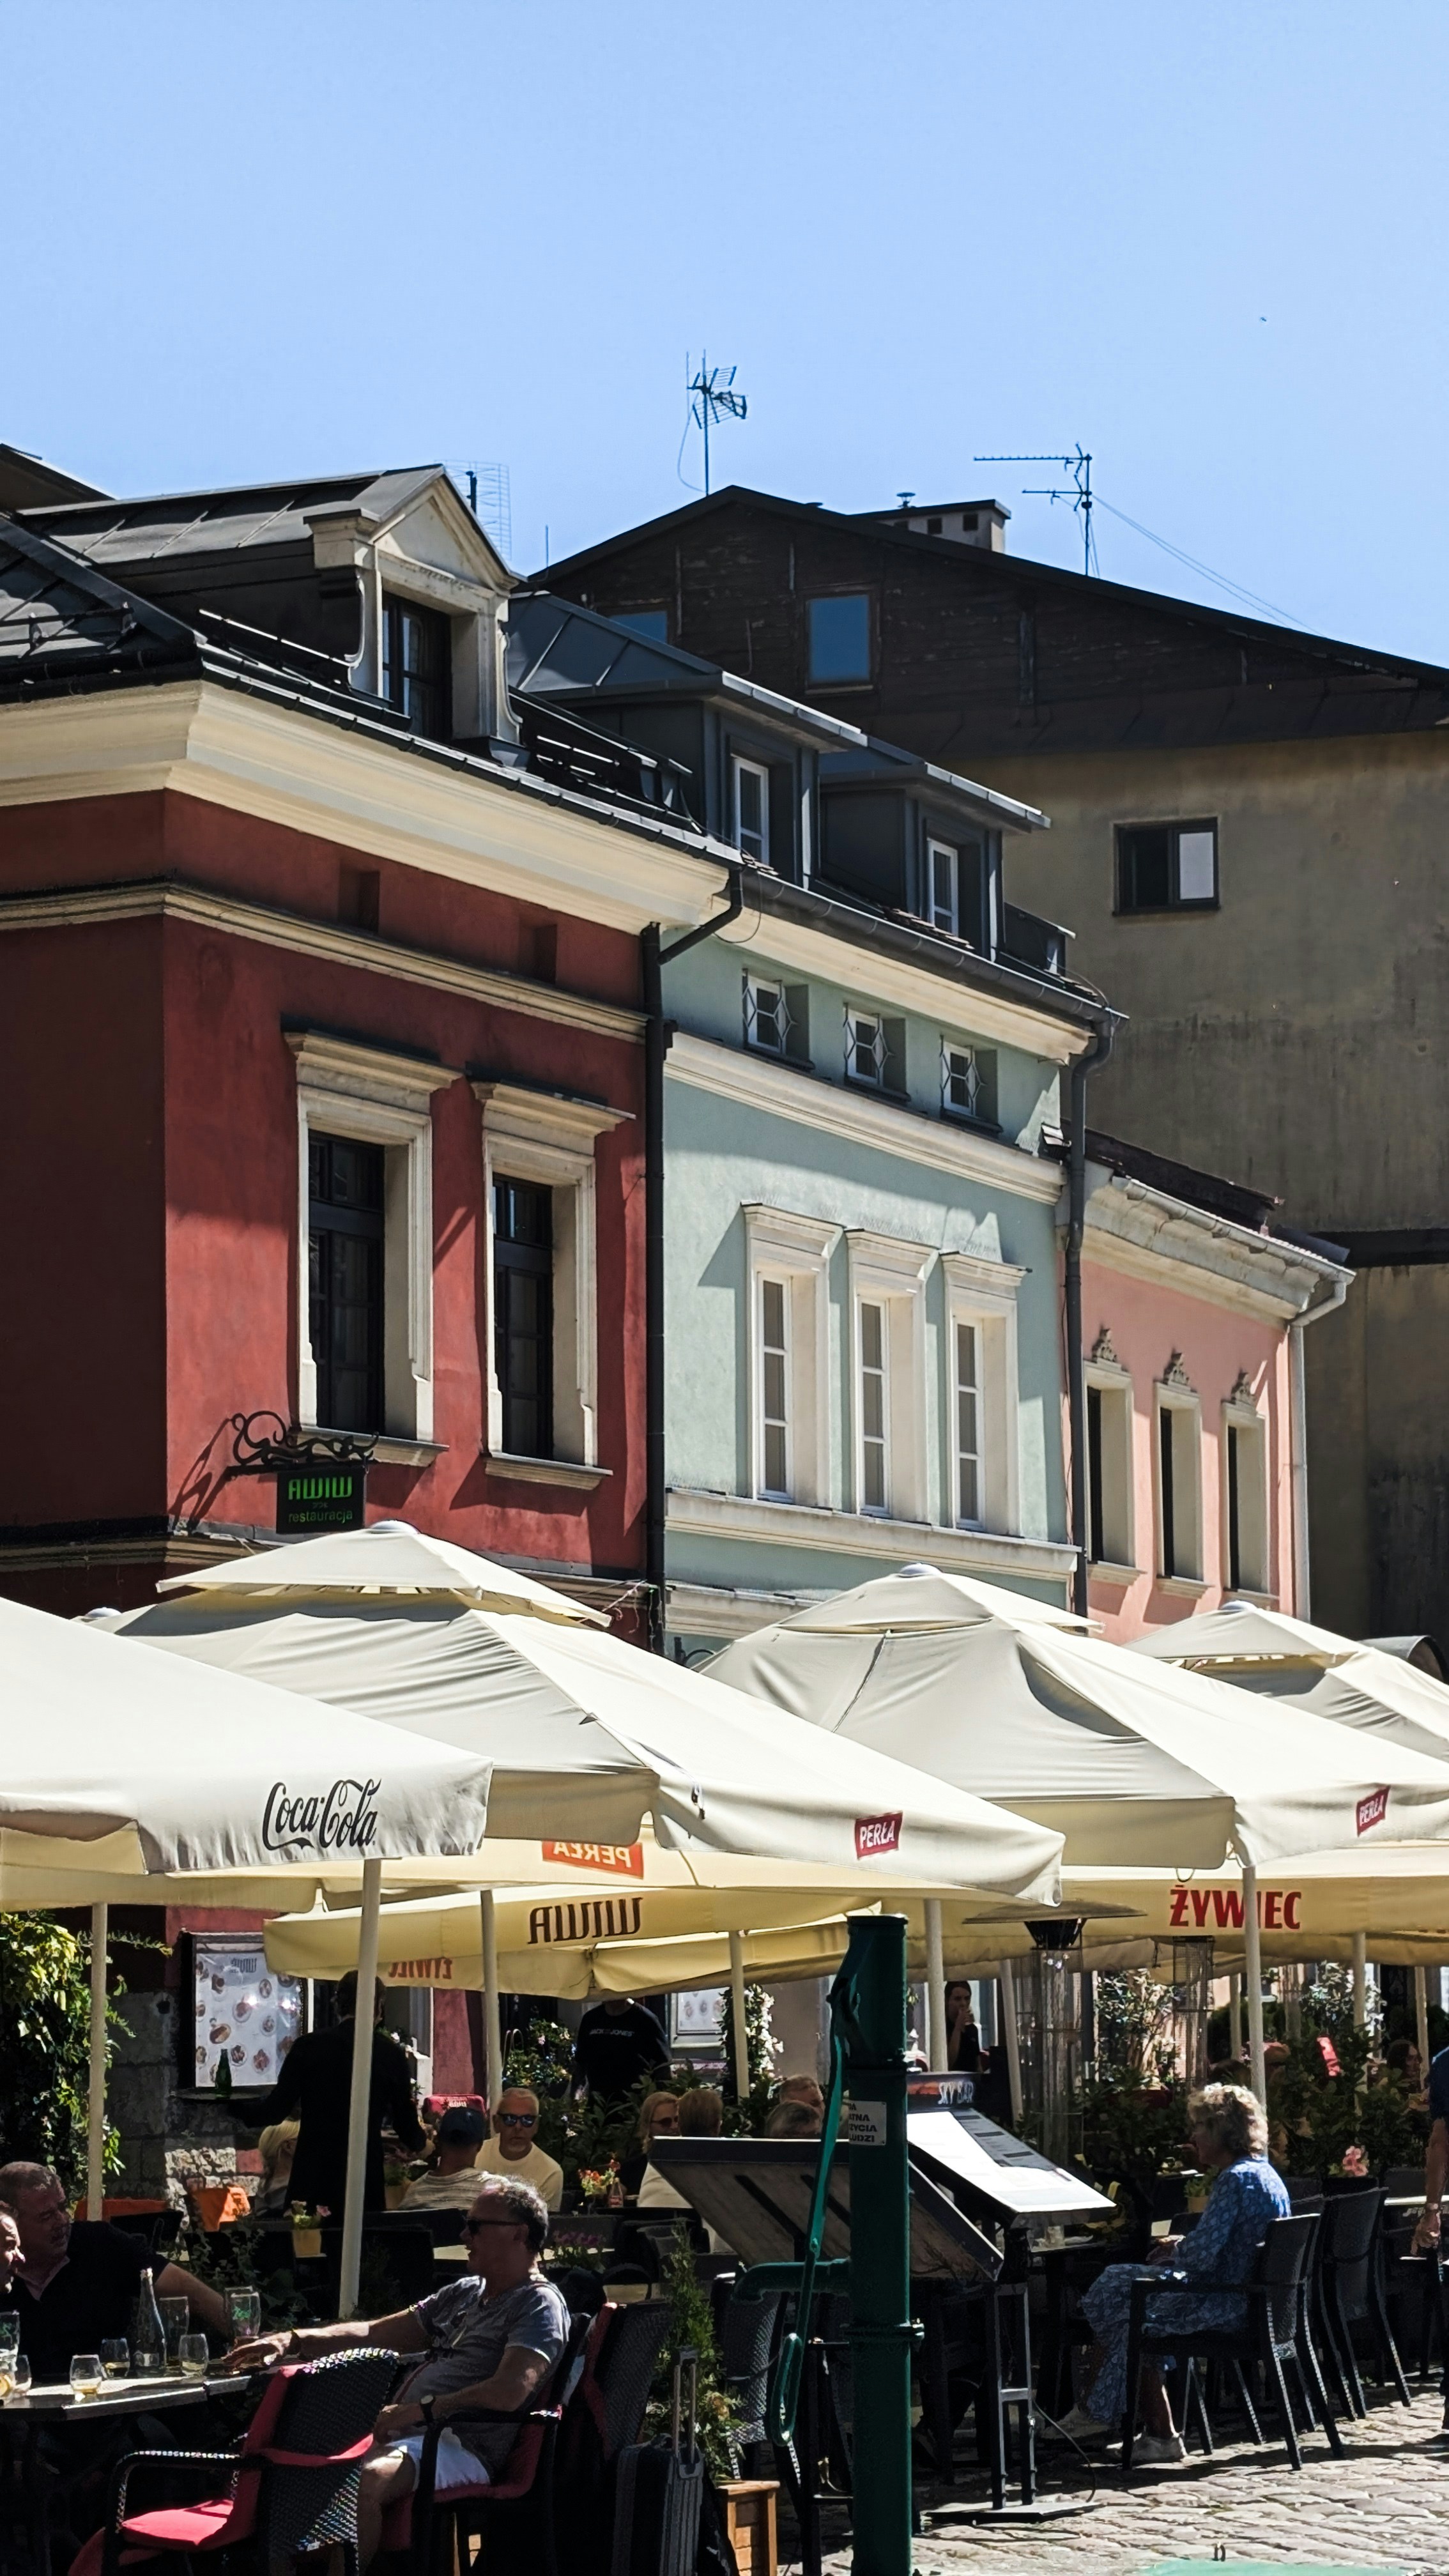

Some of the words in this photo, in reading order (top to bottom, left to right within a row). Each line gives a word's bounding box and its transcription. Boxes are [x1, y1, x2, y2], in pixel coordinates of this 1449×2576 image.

[289, 1476, 352, 1500] AWIW
[289, 1510, 353, 1524] restauracja
[262, 1779, 381, 1851] Coca-Cola
[1360, 1795, 1384, 1827] PERŁA
[859, 1820, 895, 1850] PERŁA
[527, 1897, 643, 1944] AWIW
